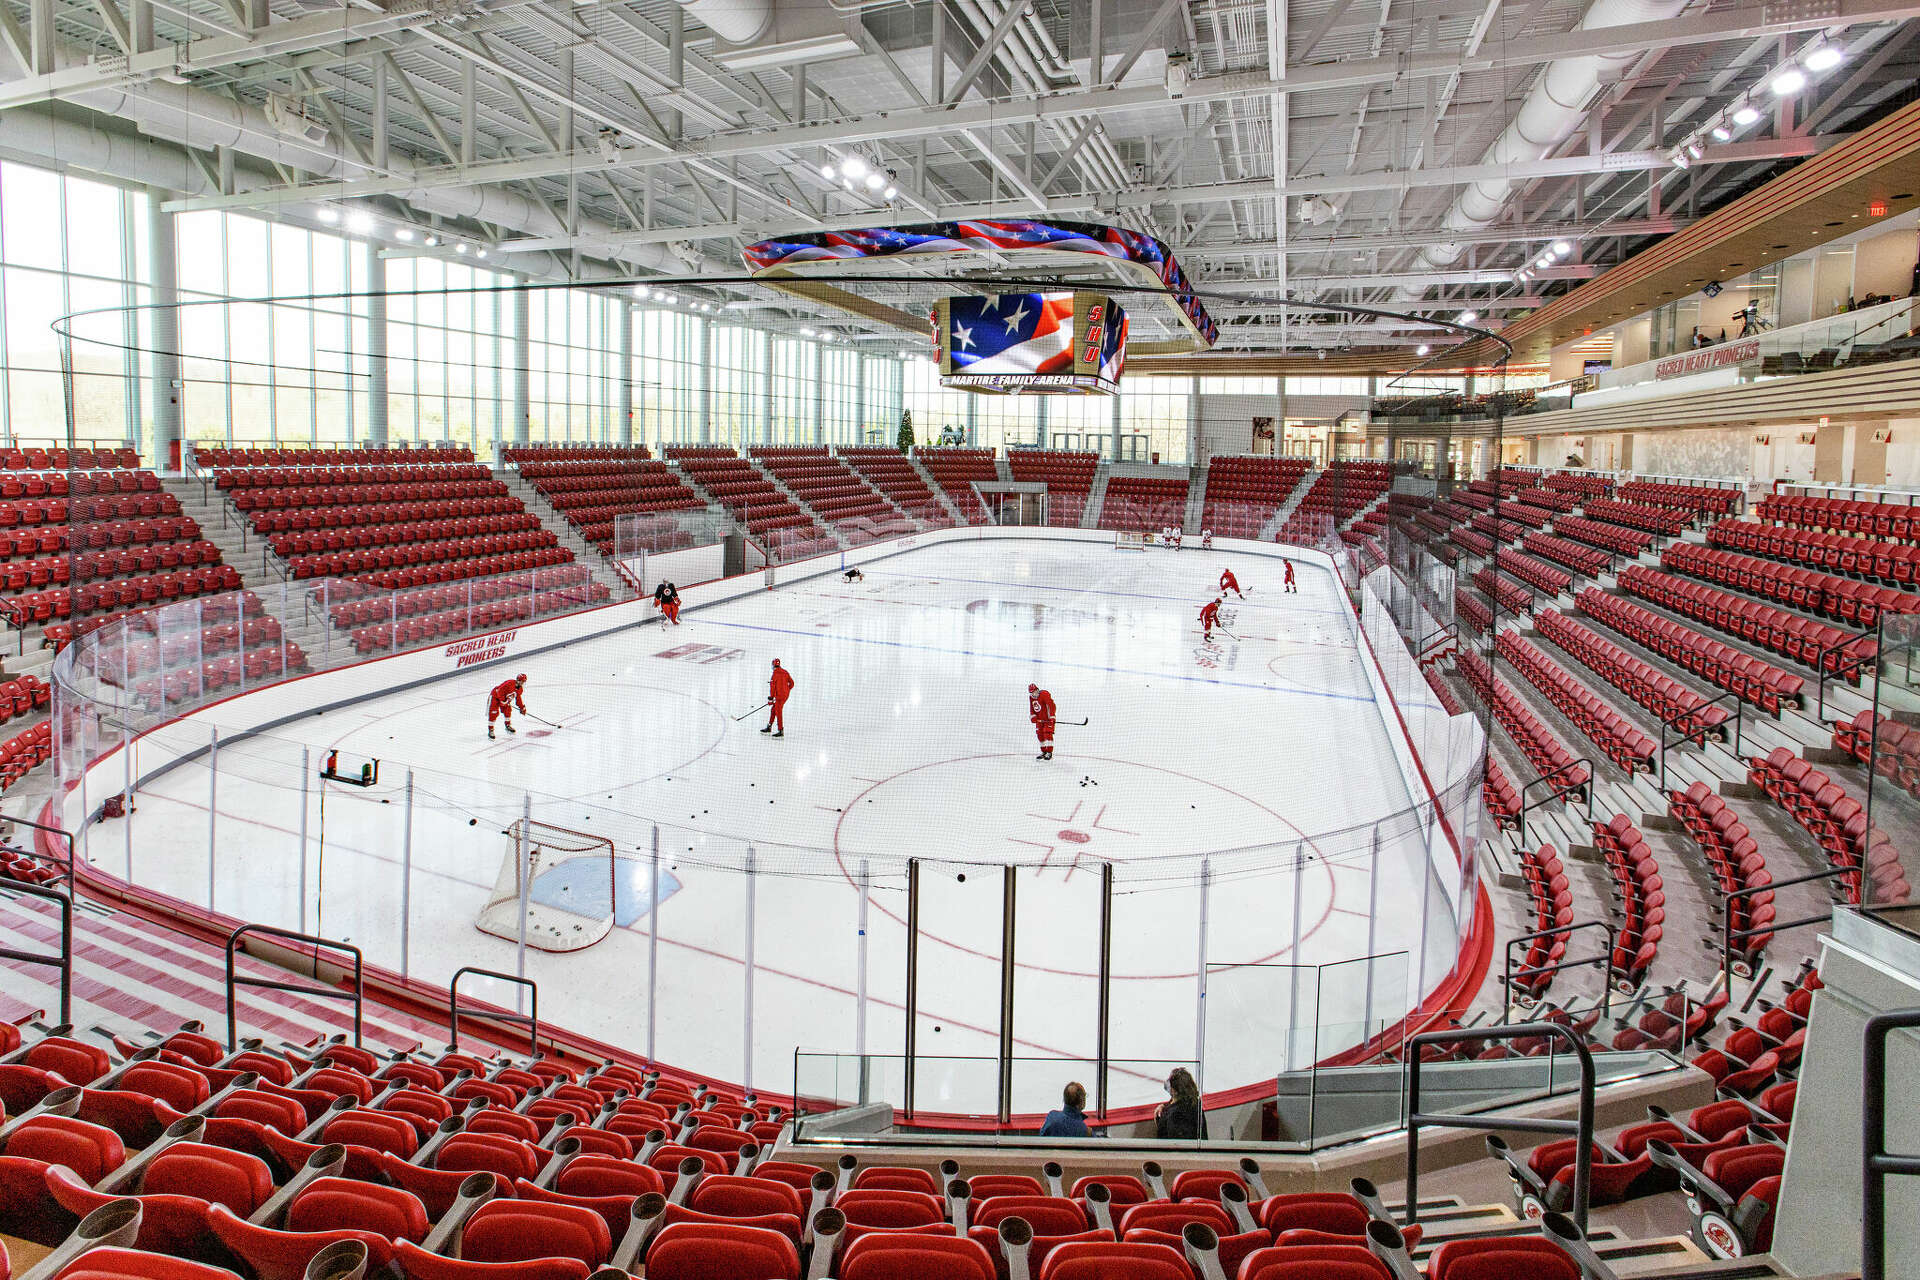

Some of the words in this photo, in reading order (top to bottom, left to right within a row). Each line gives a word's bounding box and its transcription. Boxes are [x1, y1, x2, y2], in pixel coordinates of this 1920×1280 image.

[1084, 304, 1103, 362] SHU
[1655, 357, 1684, 378] SACRED
[1684, 351, 1712, 372] HEART
[1711, 340, 1760, 369] PIONEERS
[951, 375, 996, 385] MARTIRE
[998, 375, 1037, 385] FAMILY
[1039, 375, 1075, 385] ARENA
[446, 639, 486, 657] SACRED
[486, 632, 518, 648] HEART
[456, 646, 506, 669] PIONEERS
